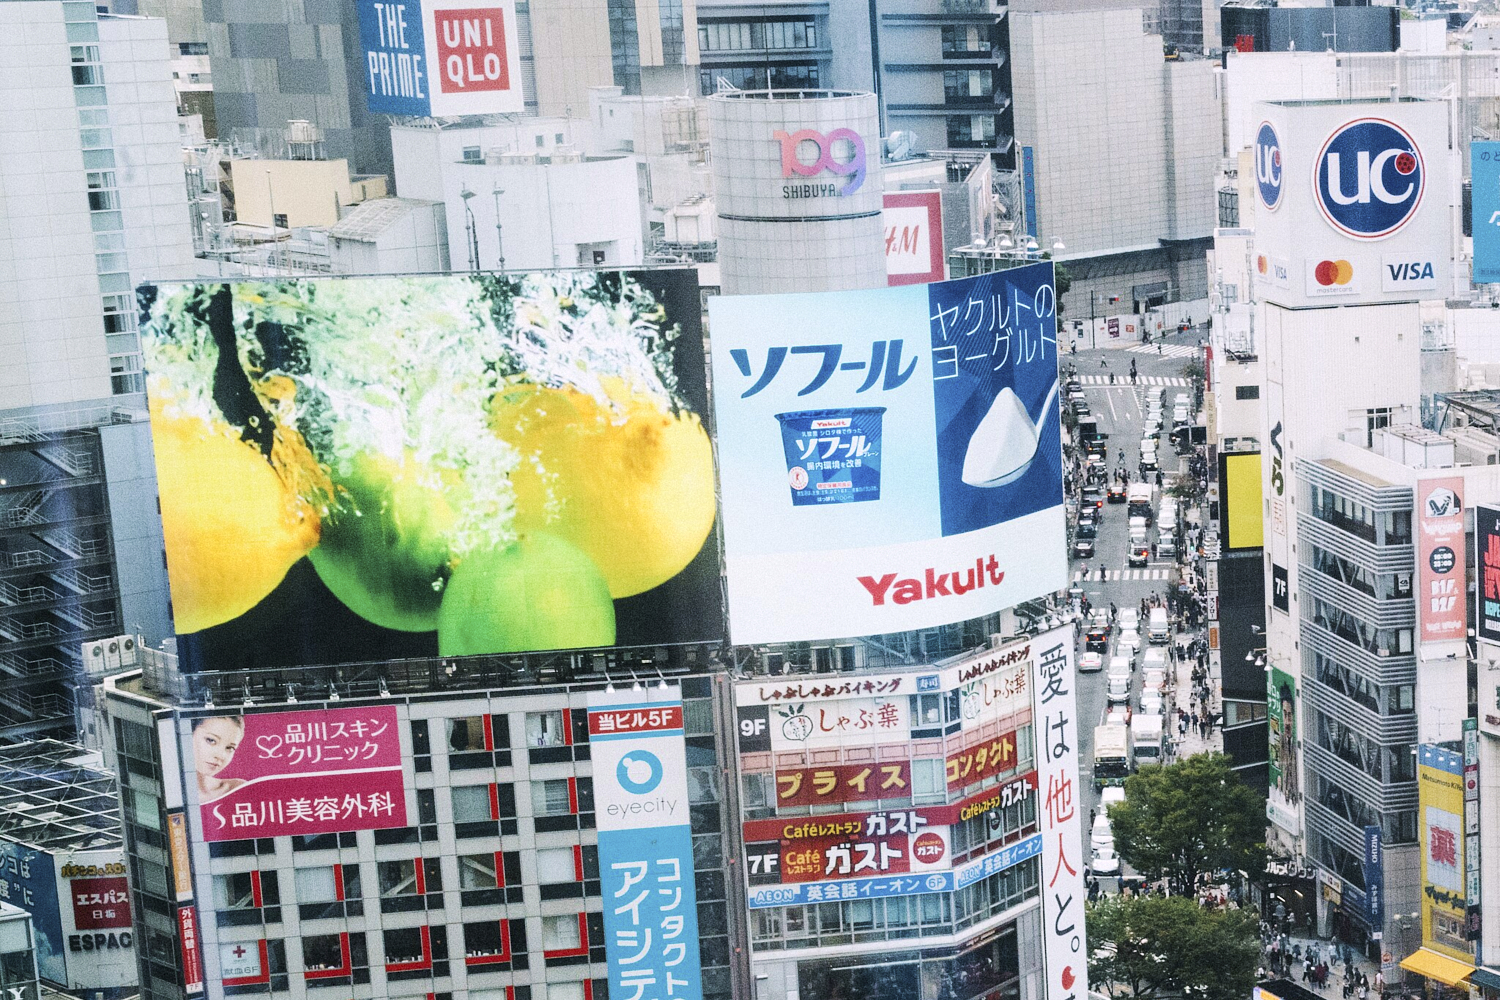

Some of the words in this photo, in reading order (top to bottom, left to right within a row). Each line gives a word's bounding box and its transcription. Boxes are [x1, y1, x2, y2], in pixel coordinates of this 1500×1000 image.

[374, 3, 408, 49] THE
[443, 18, 494, 48] UNI
[369, 50, 425, 99] PRIME
[447, 52, 501, 86] QLO
[773, 128, 867, 197] 109
[782, 184, 836, 199] SHIBUYA
[1386, 261, 1435, 282] VISA
[930, 284, 1055, 341] ヤクルトの
[730, 338, 919, 399] ソフール
[932, 327, 1057, 381] ヨーグルト
[796, 435, 872, 460] ソフール
[857, 554, 1005, 607] Yakult
[1275, 578, 1286, 597] 7F
[285, 718, 388, 745] 品川スキン
[598, 709, 673, 731] 当ビル5F
[741, 718, 766, 736] 9F
[819, 703, 899, 732] しゃぶ葉
[287, 741, 379, 765] クリニック
[777, 766, 906, 798] プライス
[947, 740, 1015, 783] コンタクト
[1001, 779, 1032, 808] ガスト
[1039, 642, 1081, 954] 愛は他人と。
[232, 791, 395, 828] 品川美容外科
[606, 798, 678, 819] eyecity
[866, 811, 927, 837] ガスト
[748, 854, 779, 876] 7F
[786, 852, 820, 867] Café
[825, 842, 903, 876] ガスト
[755, 889, 795, 904] AEON
[806, 878, 920, 901] 英会話イーオン
[182, 908, 195, 950] 外貨両替
